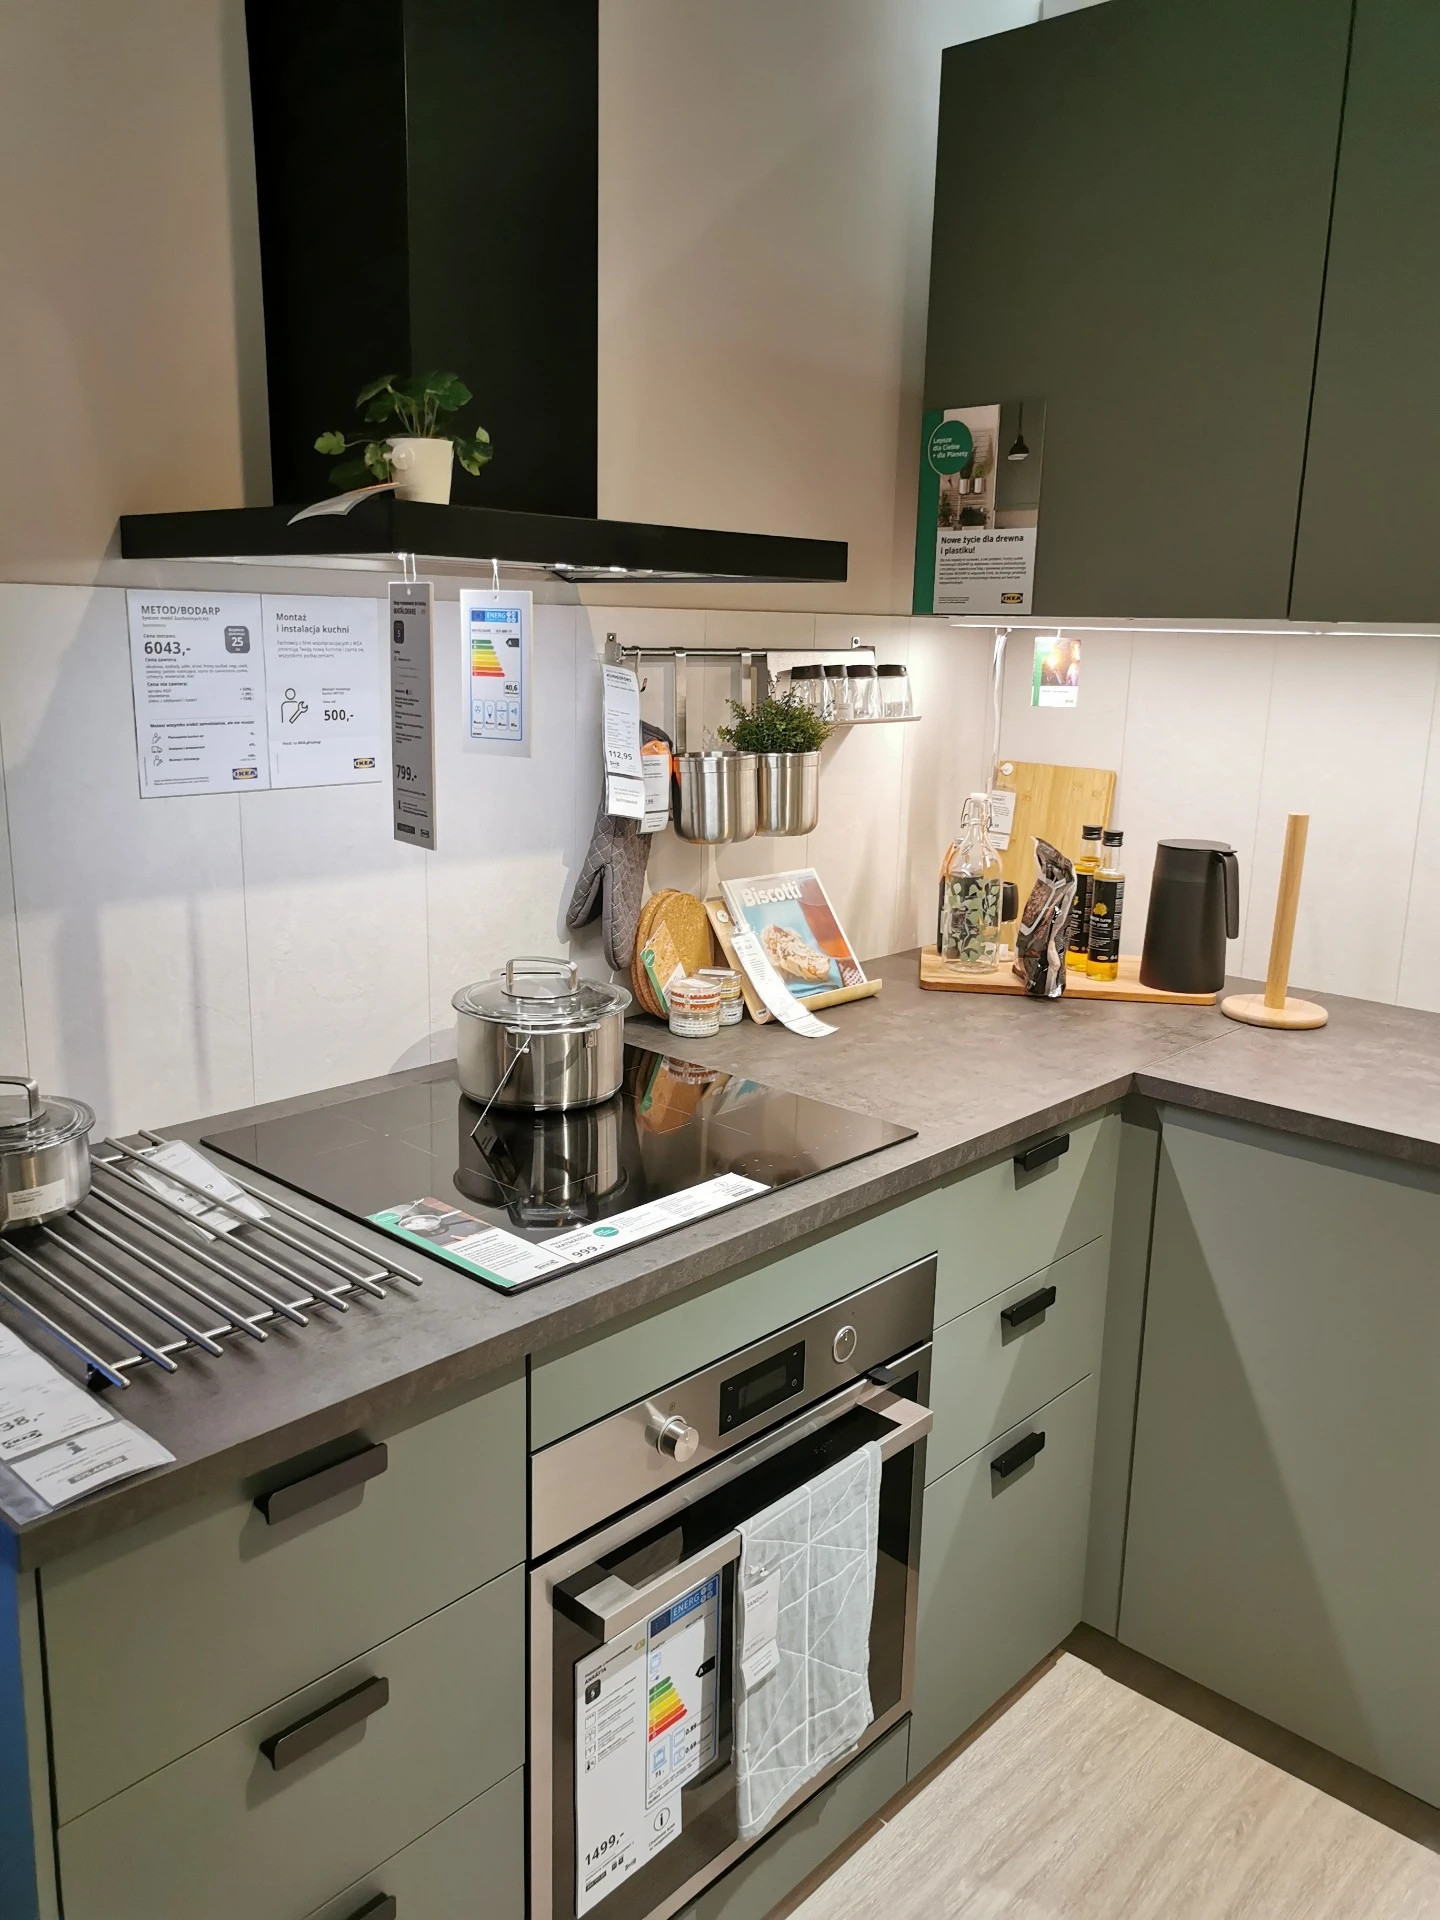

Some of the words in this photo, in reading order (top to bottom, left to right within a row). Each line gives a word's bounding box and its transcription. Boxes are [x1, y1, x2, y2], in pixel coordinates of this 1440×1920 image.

[940, 536, 961, 545] Nowe
[962, 535, 981, 546] życie
[982, 535, 994, 543] dla
[995, 534, 1024, 543] drewna
[944, 546, 976, 556] plastiku!
[141, 605, 220, 616] METOD/BODARP
[486, 611, 506, 619] ENERG
[276, 612, 307, 622] Montaż
[281, 624, 321, 635] instalacja
[322, 625, 350, 634] kuchni
[231, 637, 244, 647] 25
[144, 641, 191, 656] 6043,-
[505, 684, 518, 692] 40,6
[323, 709, 354, 722] 500,-
[609, 750, 633, 761] 112,95
[742, 880, 803, 907] Biscotti
[673, 1593, 700, 1617] ENERG
[584, 1831, 625, 1866] 1499,-
